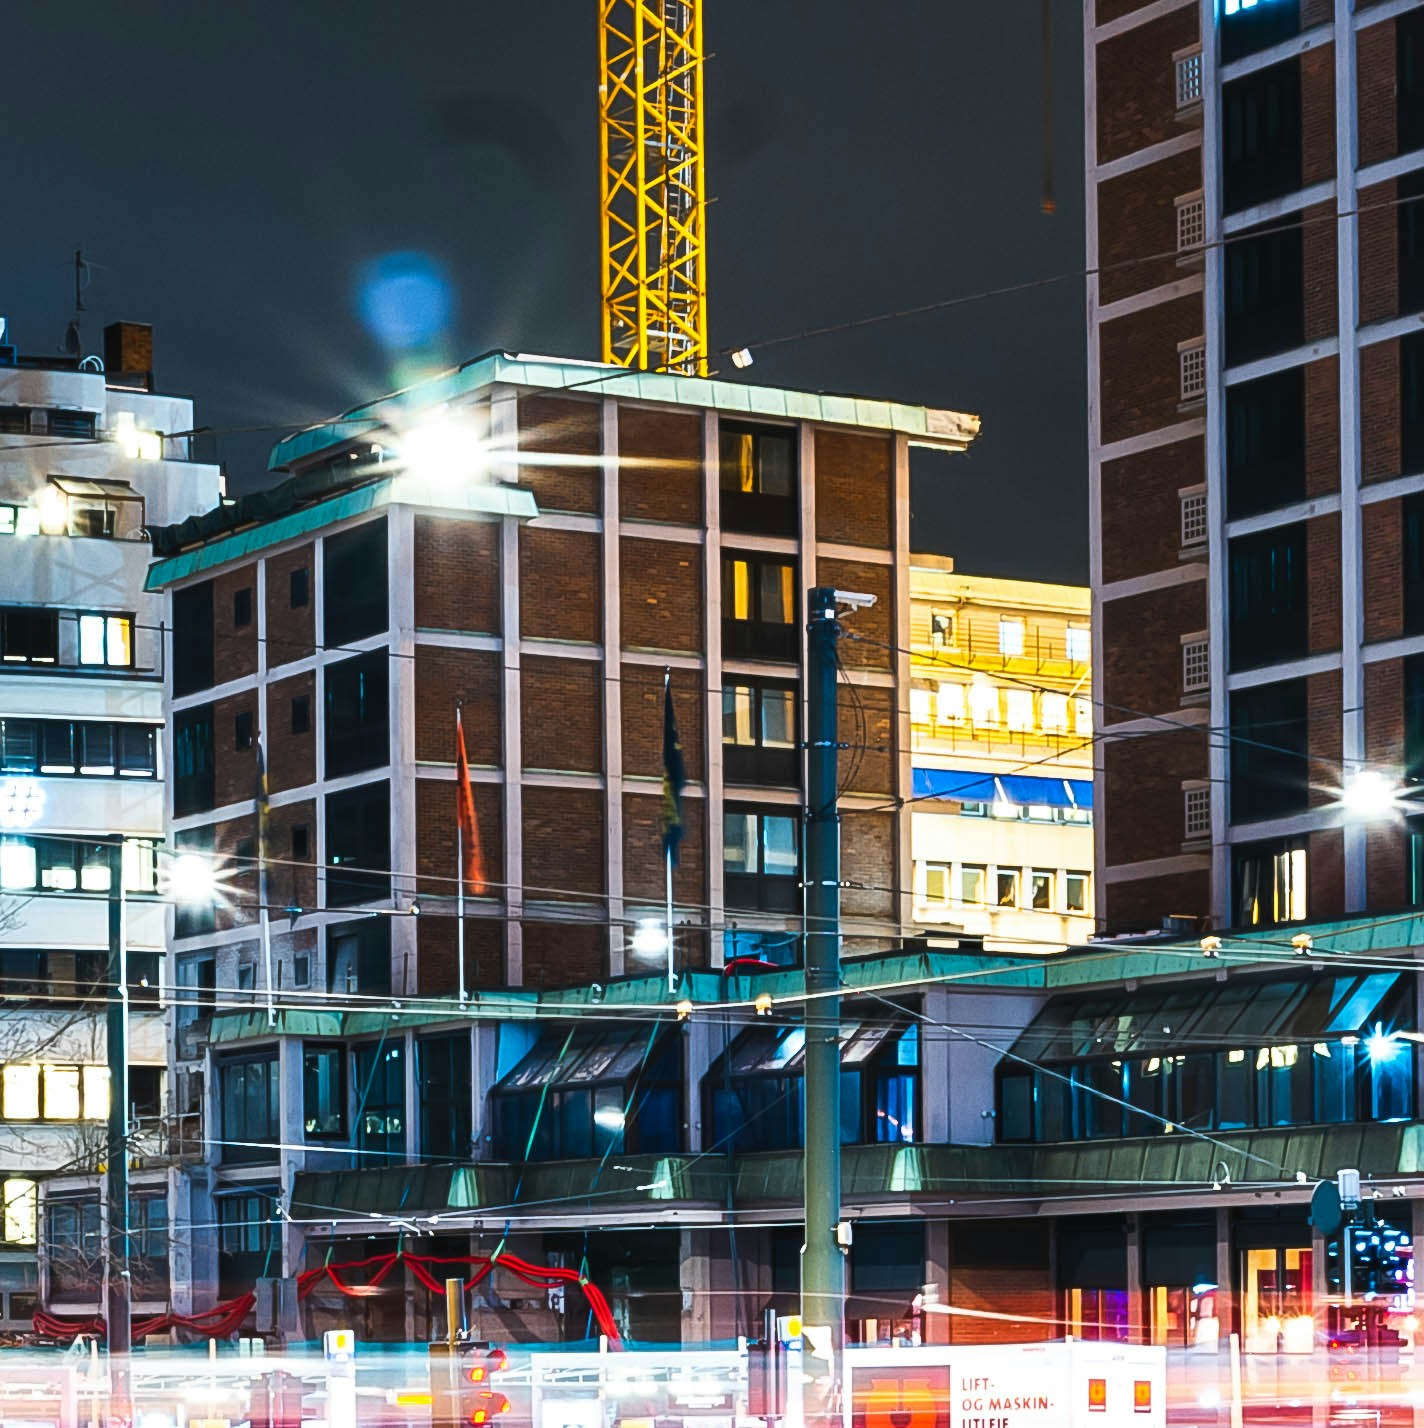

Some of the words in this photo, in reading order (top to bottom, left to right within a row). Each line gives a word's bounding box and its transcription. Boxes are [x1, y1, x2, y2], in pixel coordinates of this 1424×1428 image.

[961, 1378, 996, 1392] LIFT-
[961, 1398, 984, 1412] OG
[988, 1396, 1056, 1411] MASKIN-
